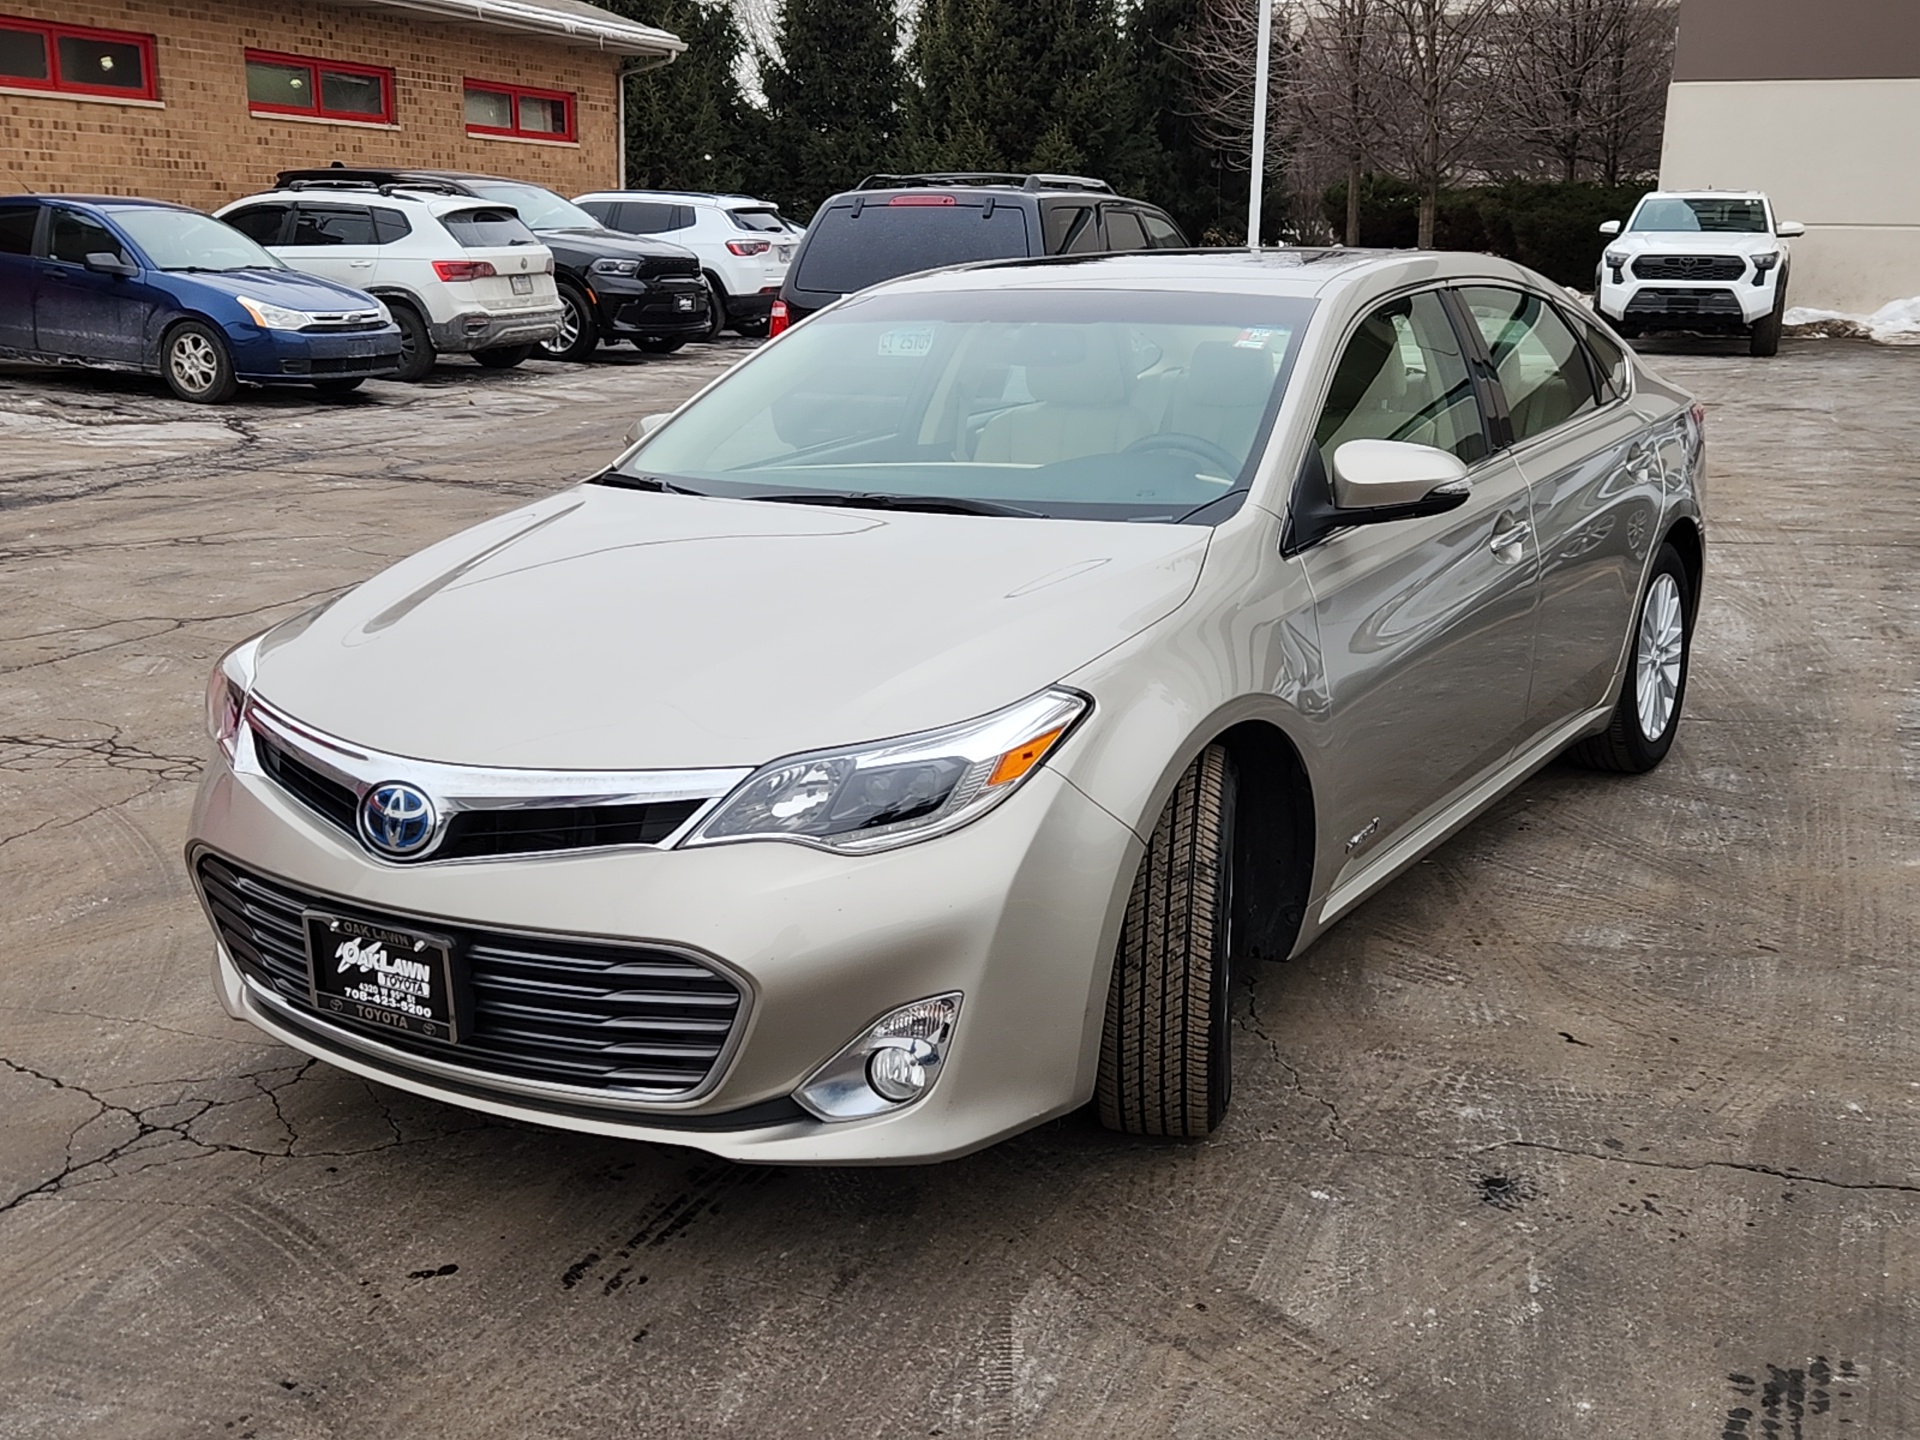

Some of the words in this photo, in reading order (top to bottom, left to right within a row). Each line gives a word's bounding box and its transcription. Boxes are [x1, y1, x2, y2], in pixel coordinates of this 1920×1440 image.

[343, 921, 371, 937] OAK
[371, 928, 409, 946] LAWN
[382, 973, 424, 995] TOYOTA
[344, 986, 432, 1018] 708-423-5200
[356, 1004, 409, 1029] TOYOTA
